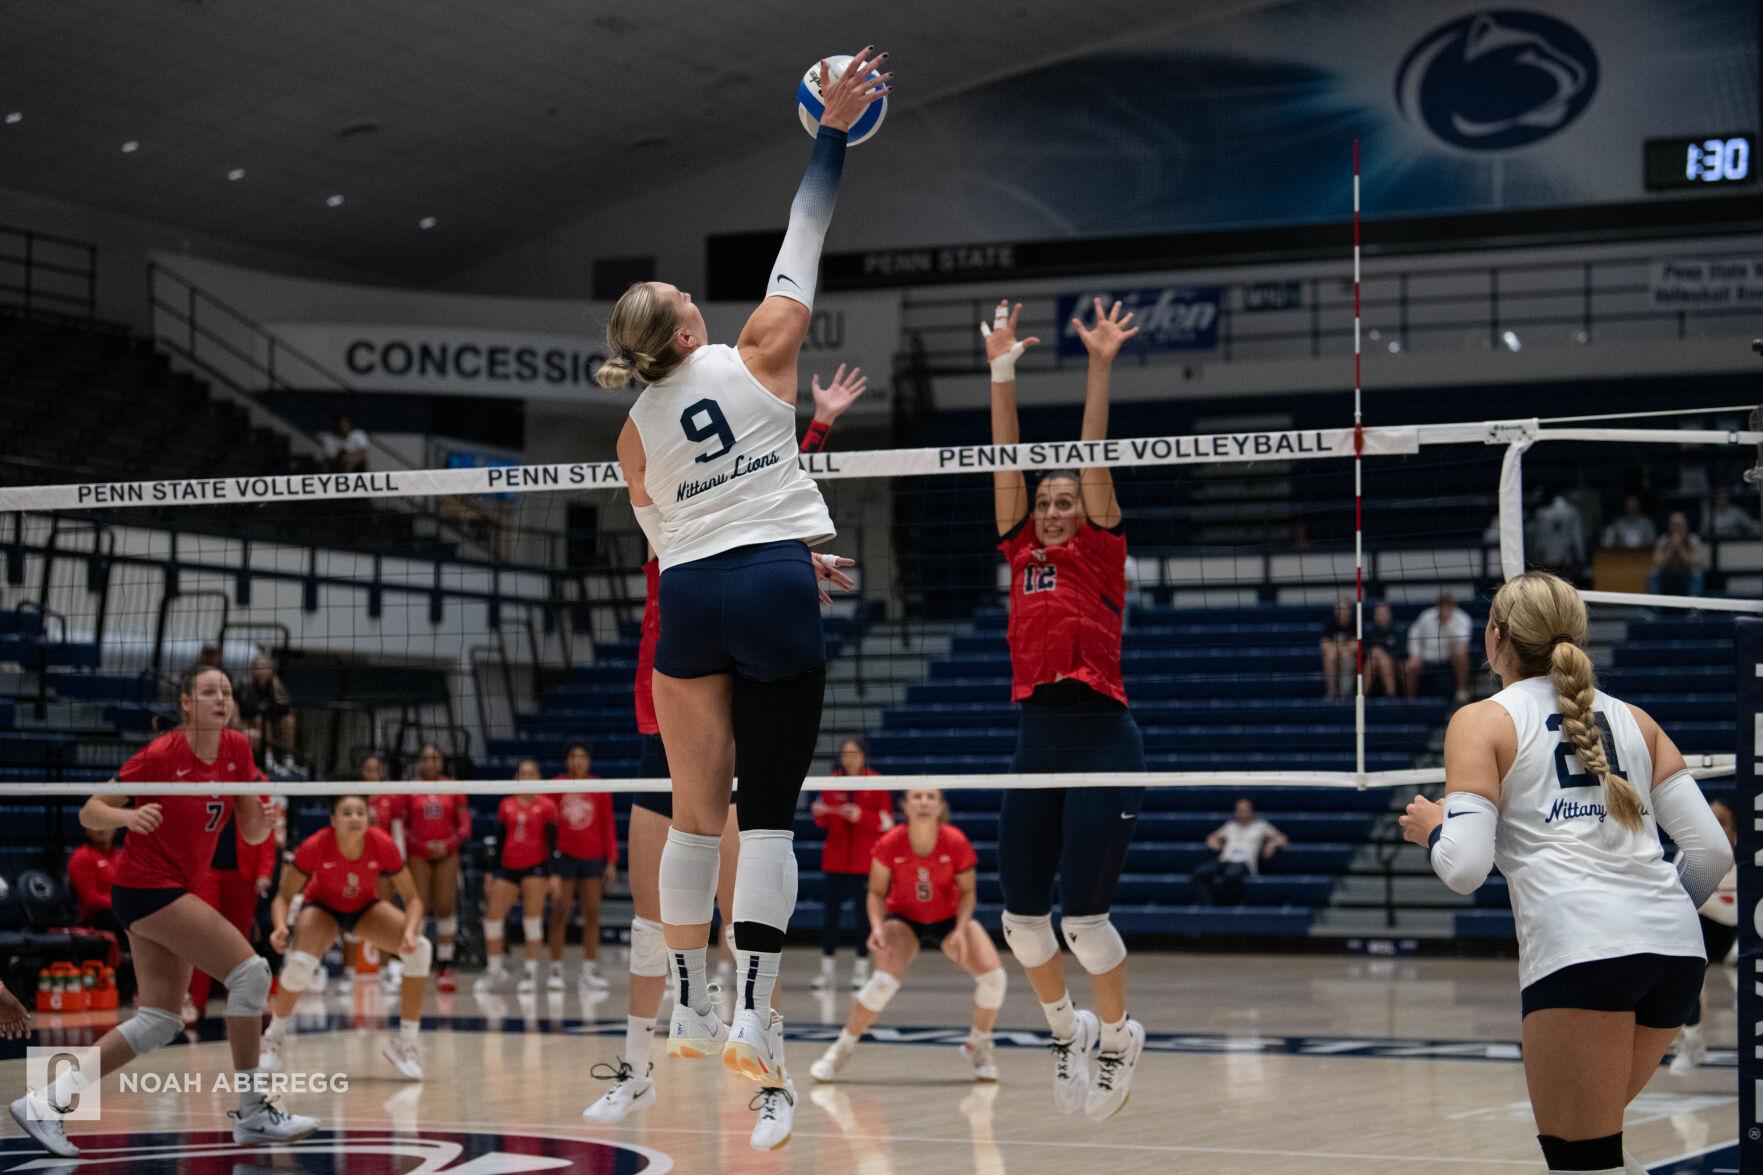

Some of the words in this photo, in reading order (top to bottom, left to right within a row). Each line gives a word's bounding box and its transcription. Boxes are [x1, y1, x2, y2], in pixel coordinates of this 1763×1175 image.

[1686, 137, 1750, 182] 1:30
[680, 398, 736, 463] 9
[731, 450, 779, 479] Lions
[939, 446, 1018, 467] PENN
[1029, 441, 1120, 464] STATE
[1131, 432, 1333, 460] VOLLEYBALL
[78, 482, 143, 503] PENN
[153, 480, 226, 500] STATE
[236, 473, 399, 498] VOLLEYBALL
[488, 467, 559, 488] PENN
[1024, 563, 1057, 595] 12
[205, 802, 225, 832] 7
[1545, 798, 1608, 824] Nittany
